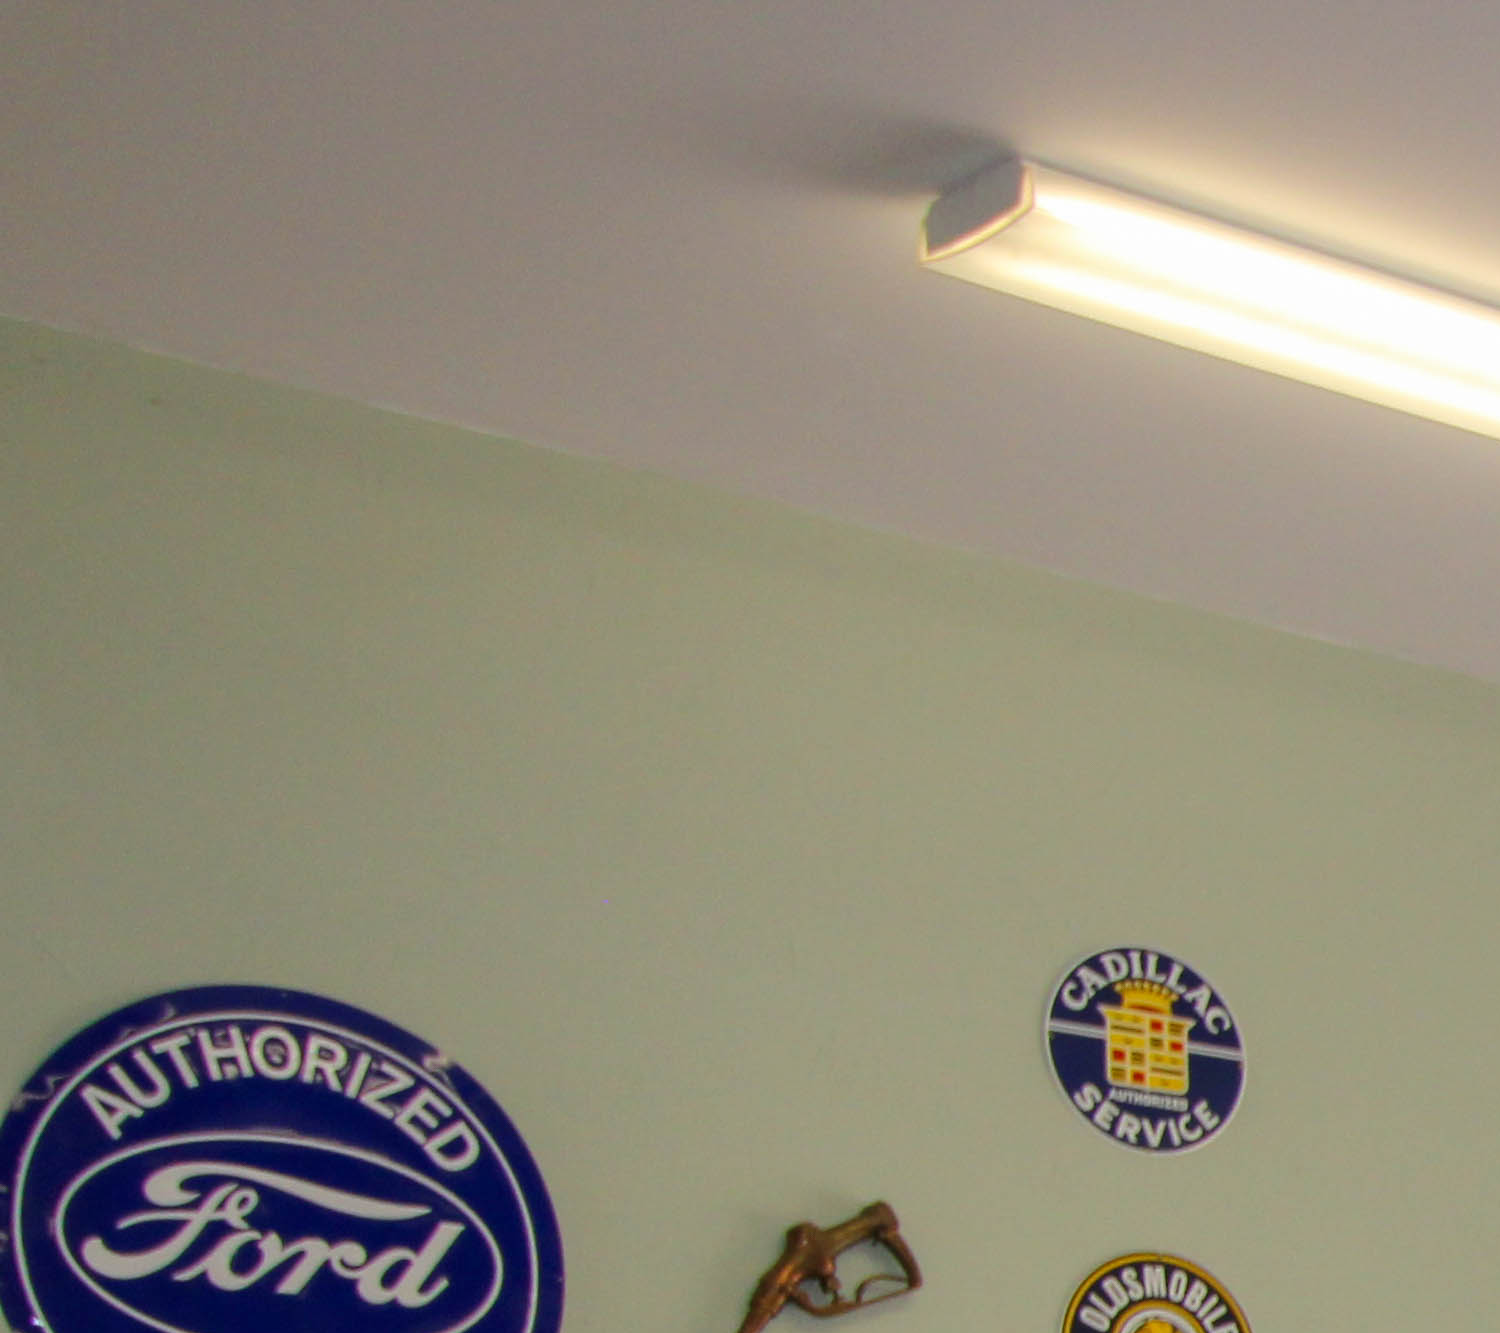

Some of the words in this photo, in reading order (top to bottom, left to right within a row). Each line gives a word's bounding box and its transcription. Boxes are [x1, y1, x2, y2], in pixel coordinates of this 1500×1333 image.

[1061, 950, 1232, 1036] CADILLAC
[79, 1024, 481, 1173] AUTHORIZED
[1073, 1082, 1220, 1148] SERVICE
[1108, 1087, 1189, 1112] AUTHORIZED
[81, 1160, 467, 1308] Ford
